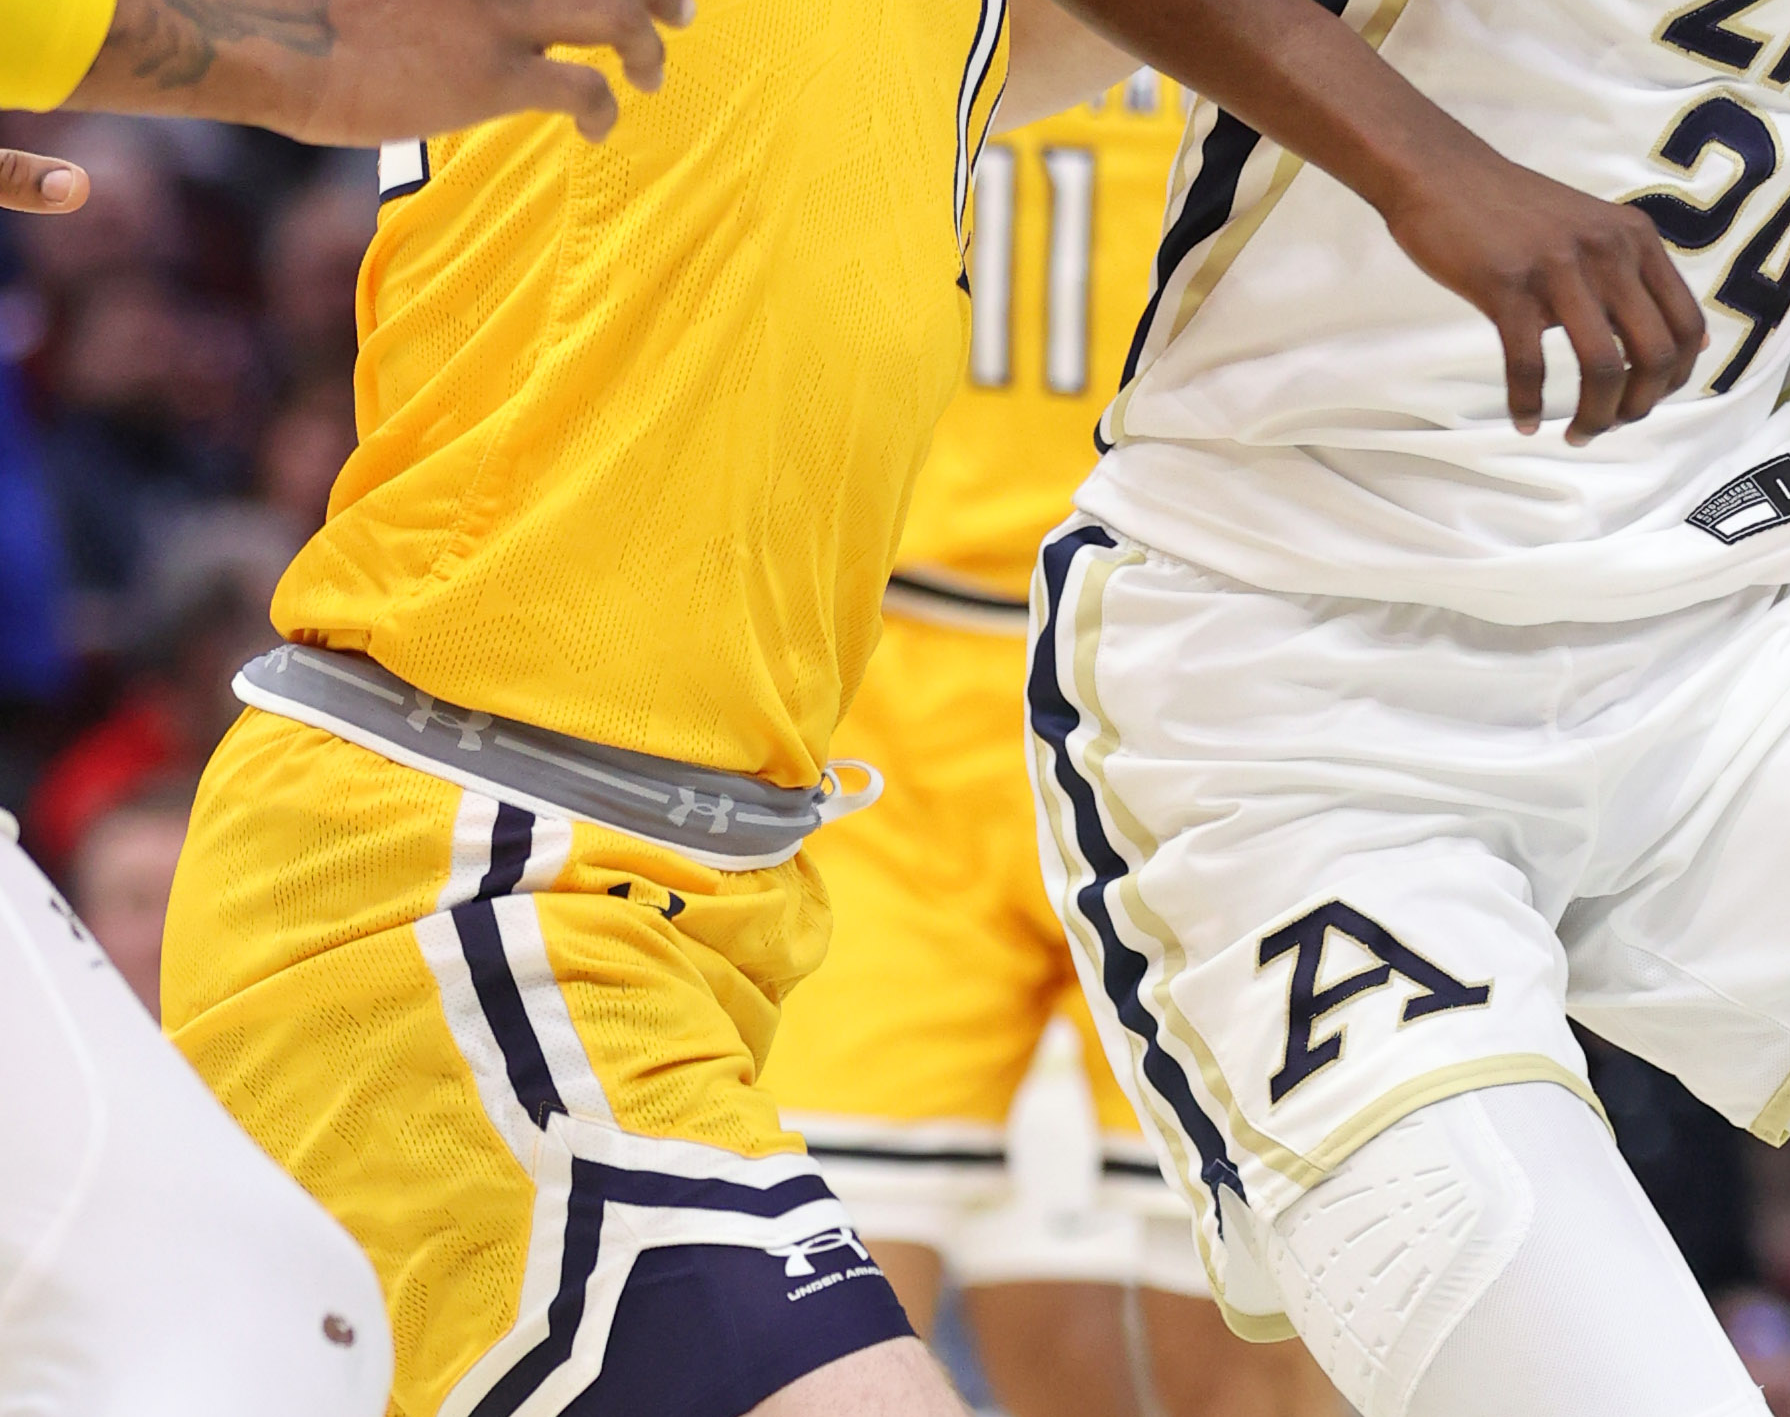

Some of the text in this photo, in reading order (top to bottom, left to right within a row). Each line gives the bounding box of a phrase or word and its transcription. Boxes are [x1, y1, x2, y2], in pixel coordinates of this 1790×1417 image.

[968, 142, 1094, 397] 11
[1256, 896, 1495, 1110] A
[786, 1271, 845, 1302] UNDER
